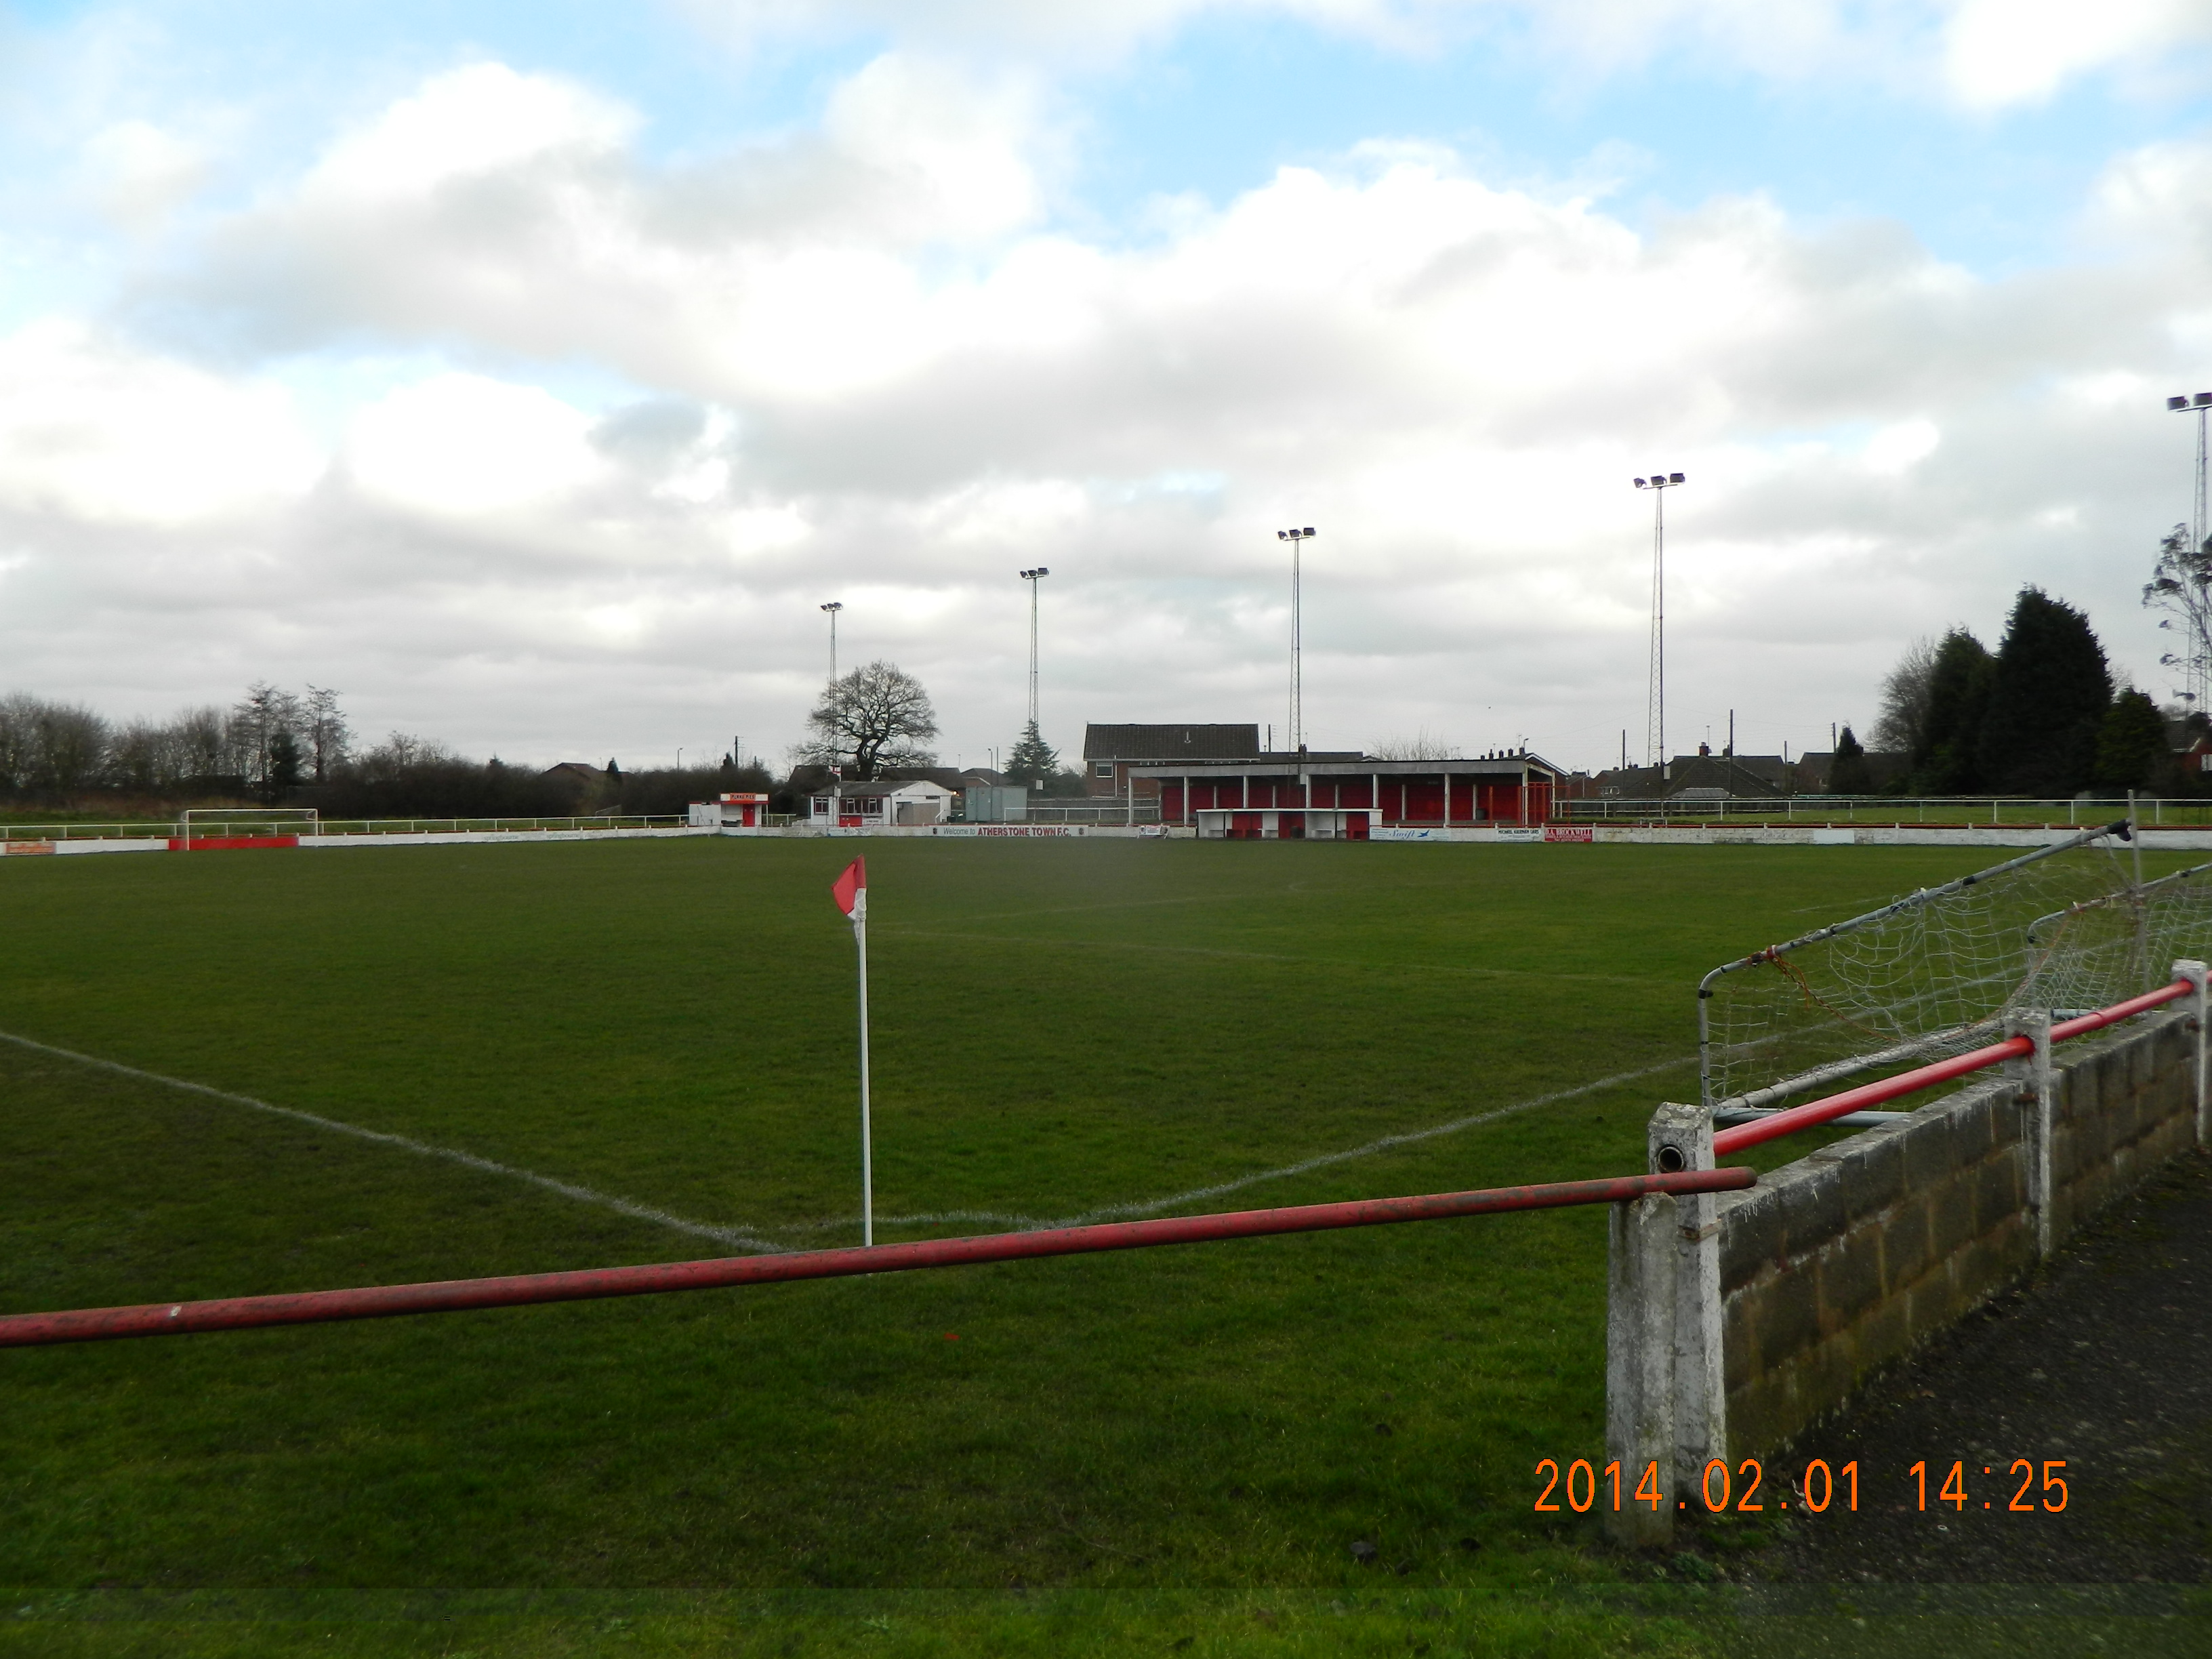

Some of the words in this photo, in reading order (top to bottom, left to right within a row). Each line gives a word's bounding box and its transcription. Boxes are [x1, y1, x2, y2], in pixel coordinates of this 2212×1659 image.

[978, 827, 1029, 836] ATHERSTONE
[1032, 827, 1056, 836] TOWN
[1389, 829, 1415, 839] Swift
